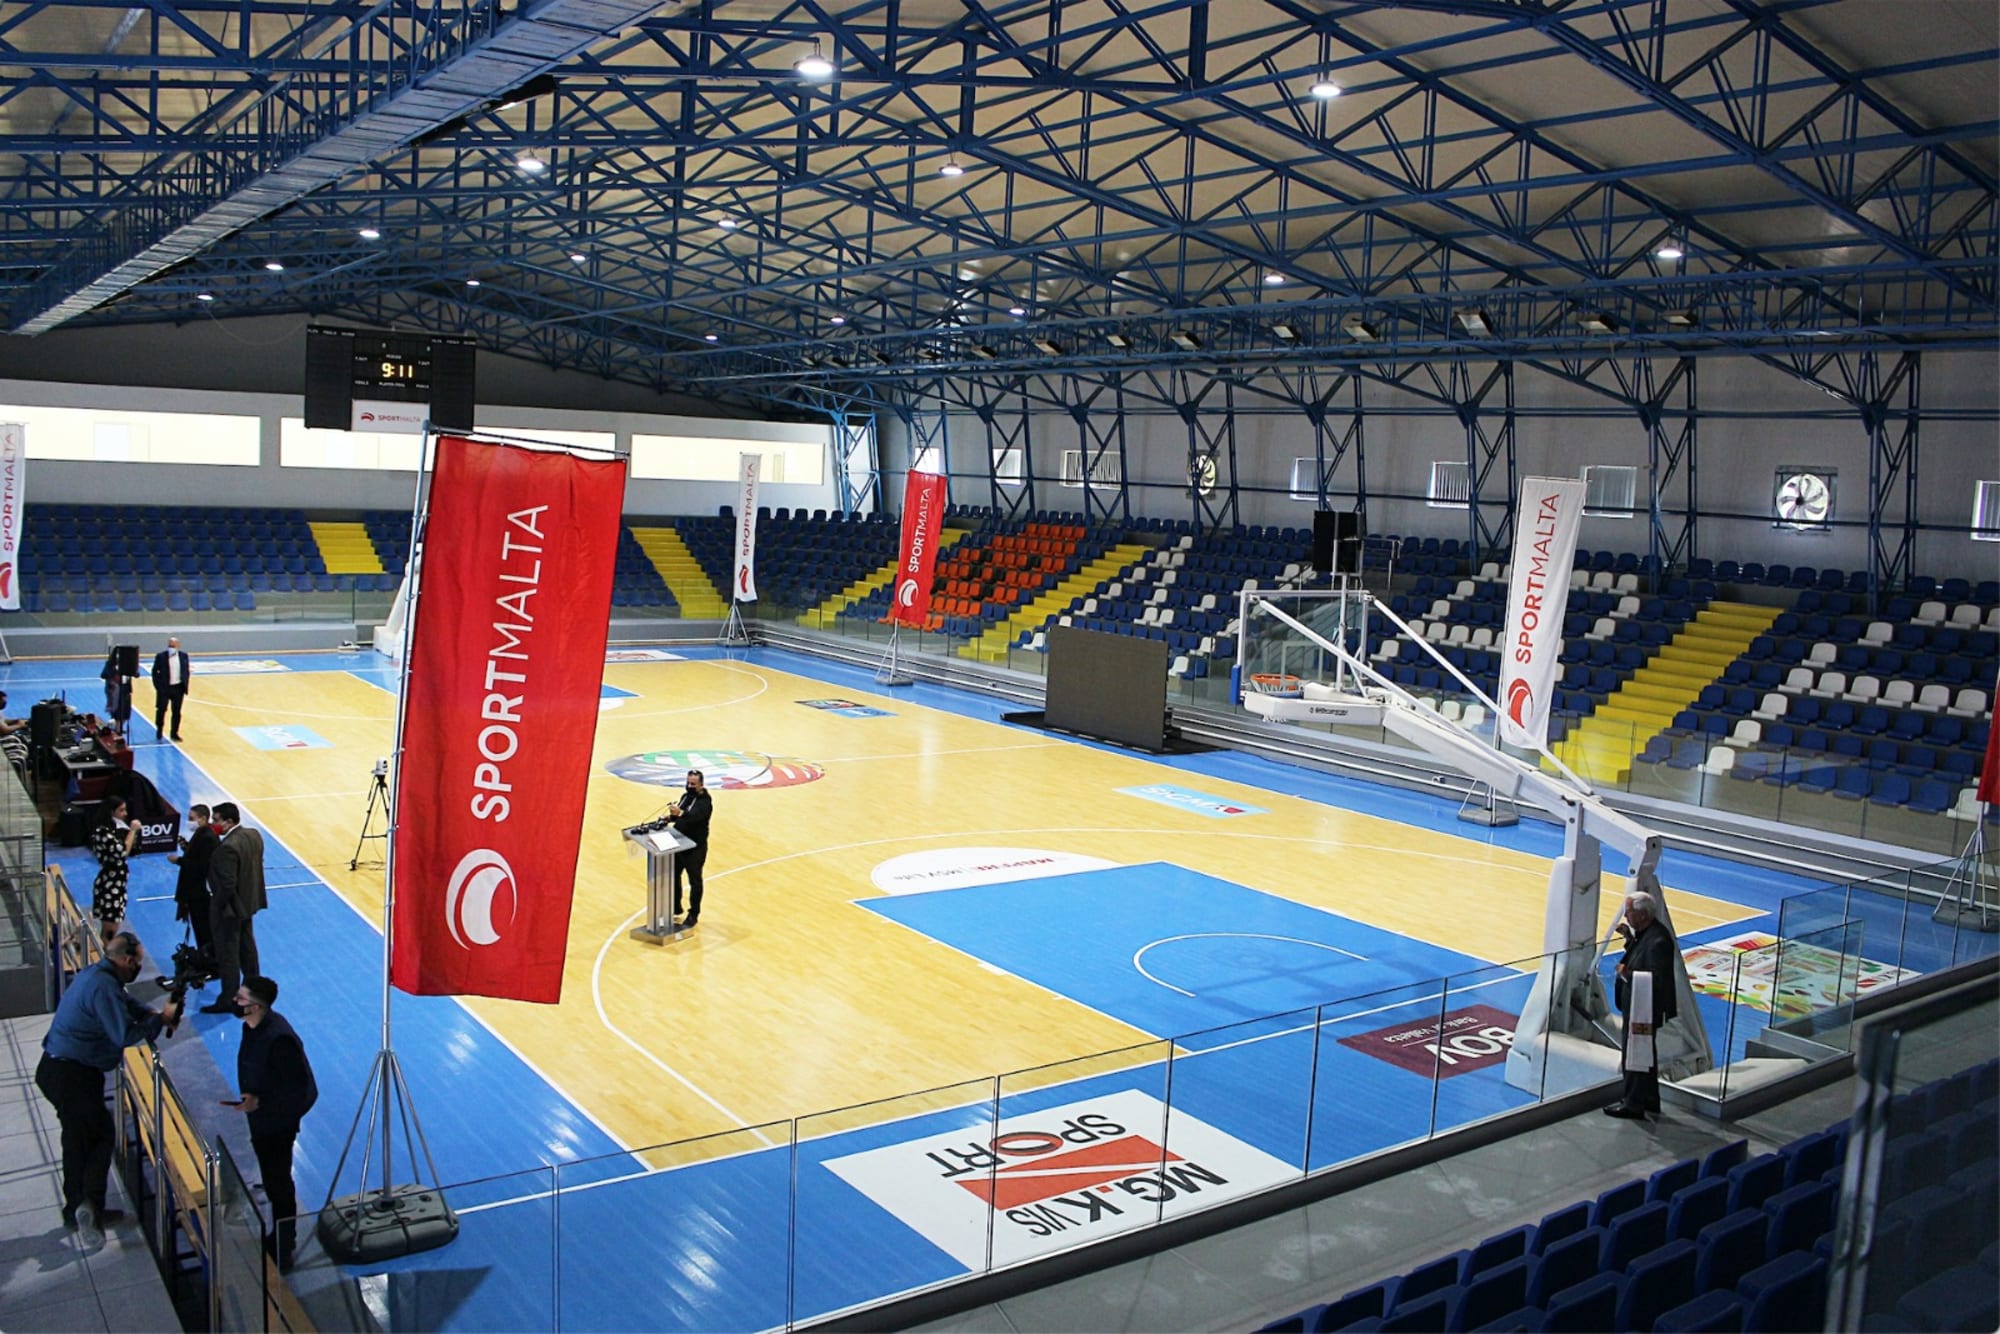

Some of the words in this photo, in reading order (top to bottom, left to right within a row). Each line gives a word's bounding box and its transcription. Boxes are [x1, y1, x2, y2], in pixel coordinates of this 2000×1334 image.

[381, 362, 413, 378] 9:11
[378, 414, 421, 423] SPORTMALTA
[2, 433, 16, 552] SPORTMALTA
[908, 488, 931, 573] SPORTMALTA
[1515, 494, 1560, 664] SPORTMALTA
[470, 504, 549, 823] SPORTMALTA
[141, 823, 173, 837] BOV
[925, 1113, 1127, 1179] SPORT
